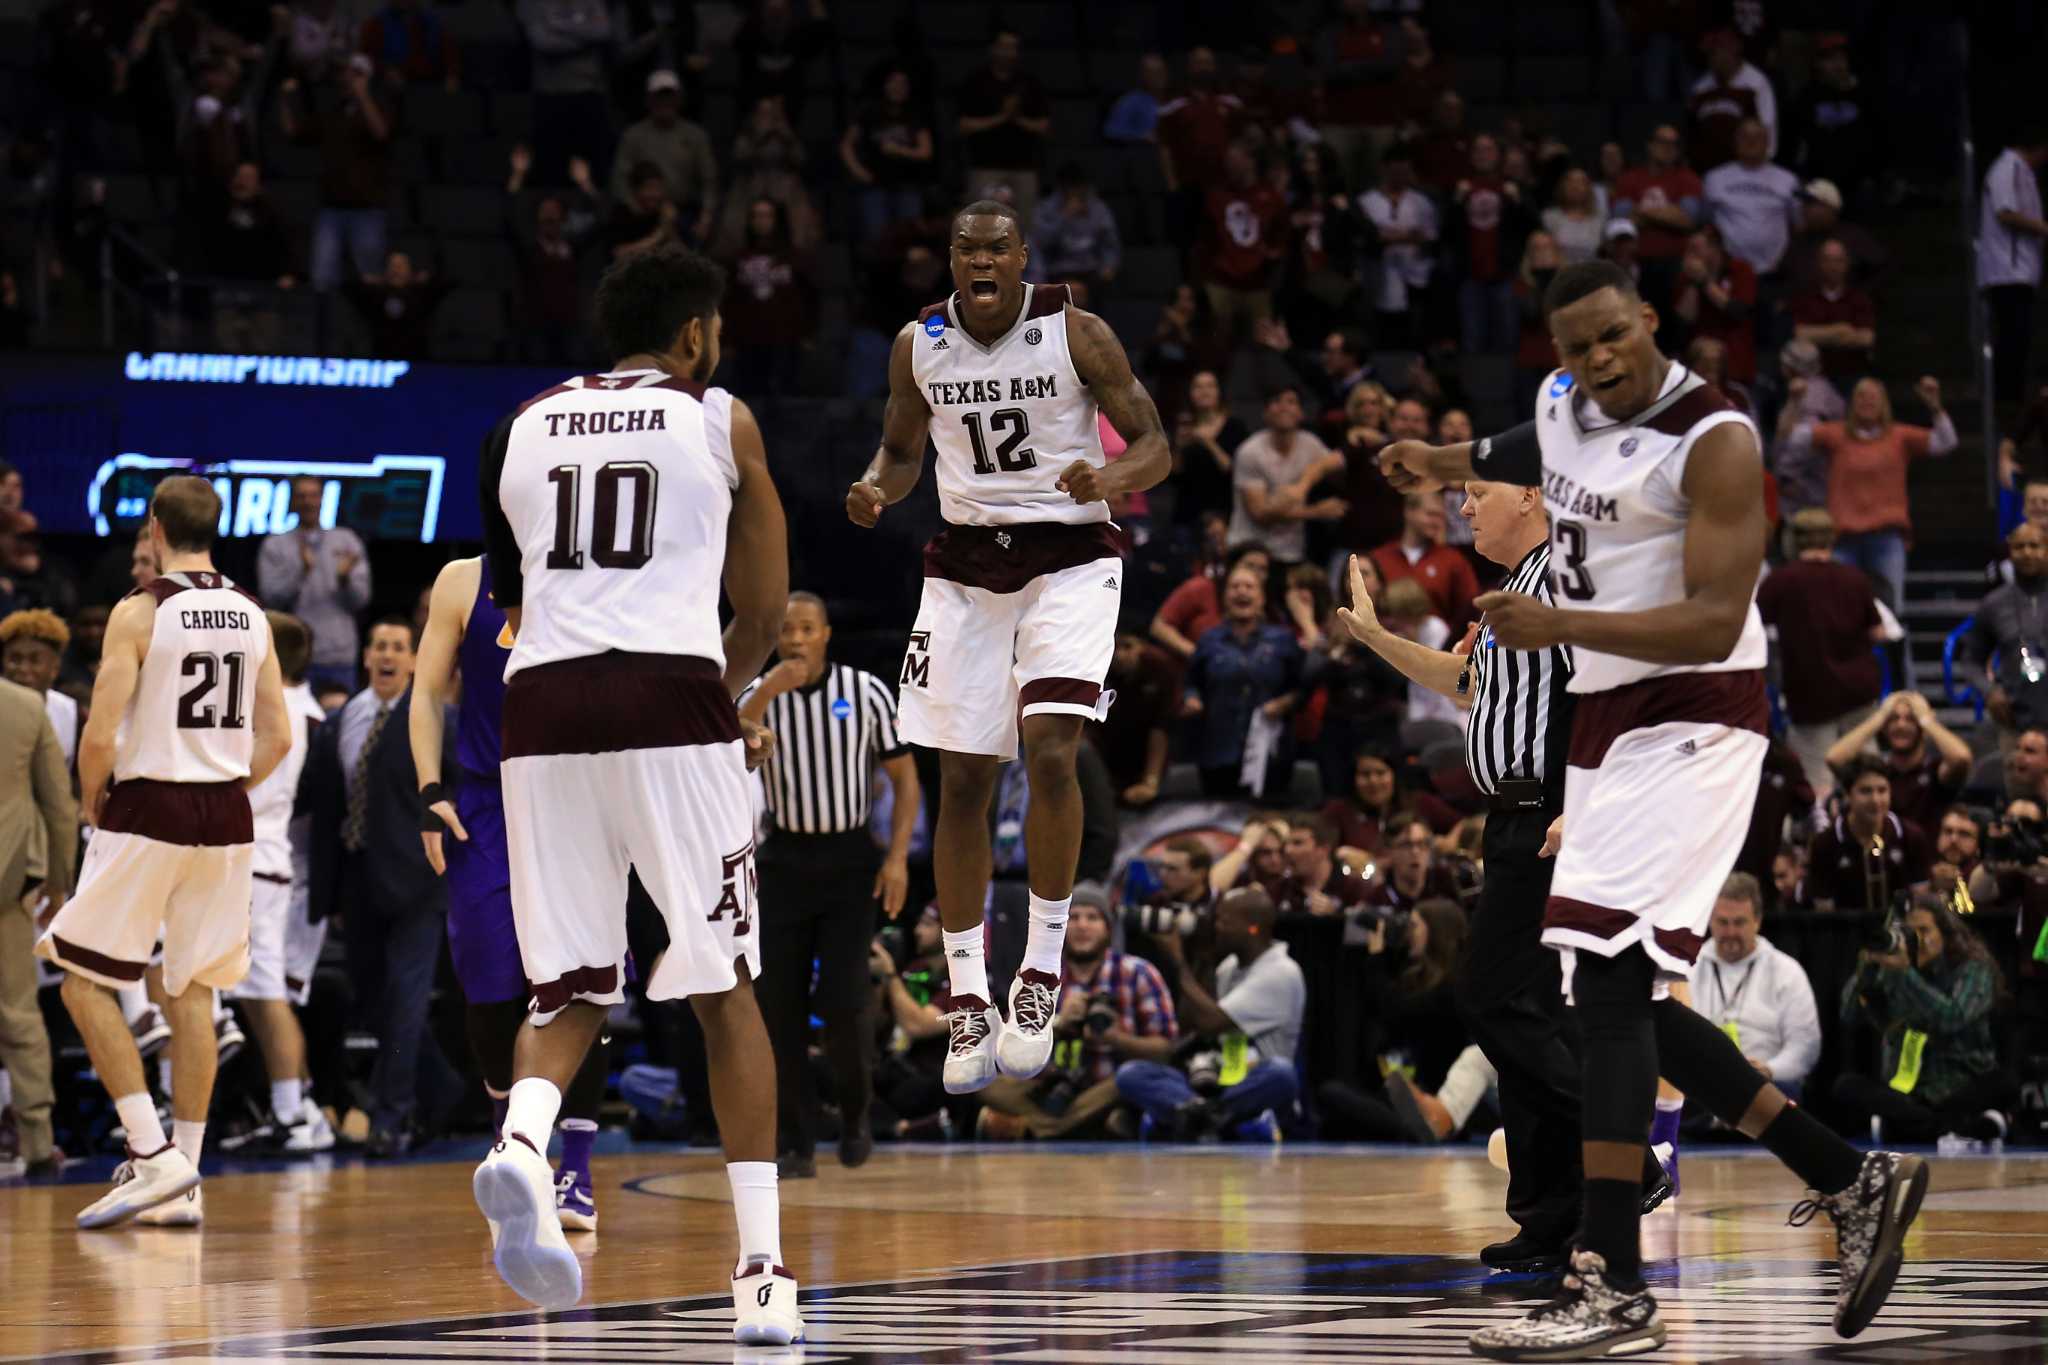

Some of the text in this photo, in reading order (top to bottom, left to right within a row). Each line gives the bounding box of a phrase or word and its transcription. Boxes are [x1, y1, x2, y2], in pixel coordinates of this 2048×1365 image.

[928, 374, 1058, 405] TEXAS A&M
[545, 408, 666, 437] TROCHA
[961, 407, 1038, 475] 12
[546, 460, 659, 570] 10
[1569, 487, 1619, 522] A&M
[1551, 518, 1597, 601] 3
[181, 609, 250, 631] CARUSO
[177, 651, 245, 729] 21
